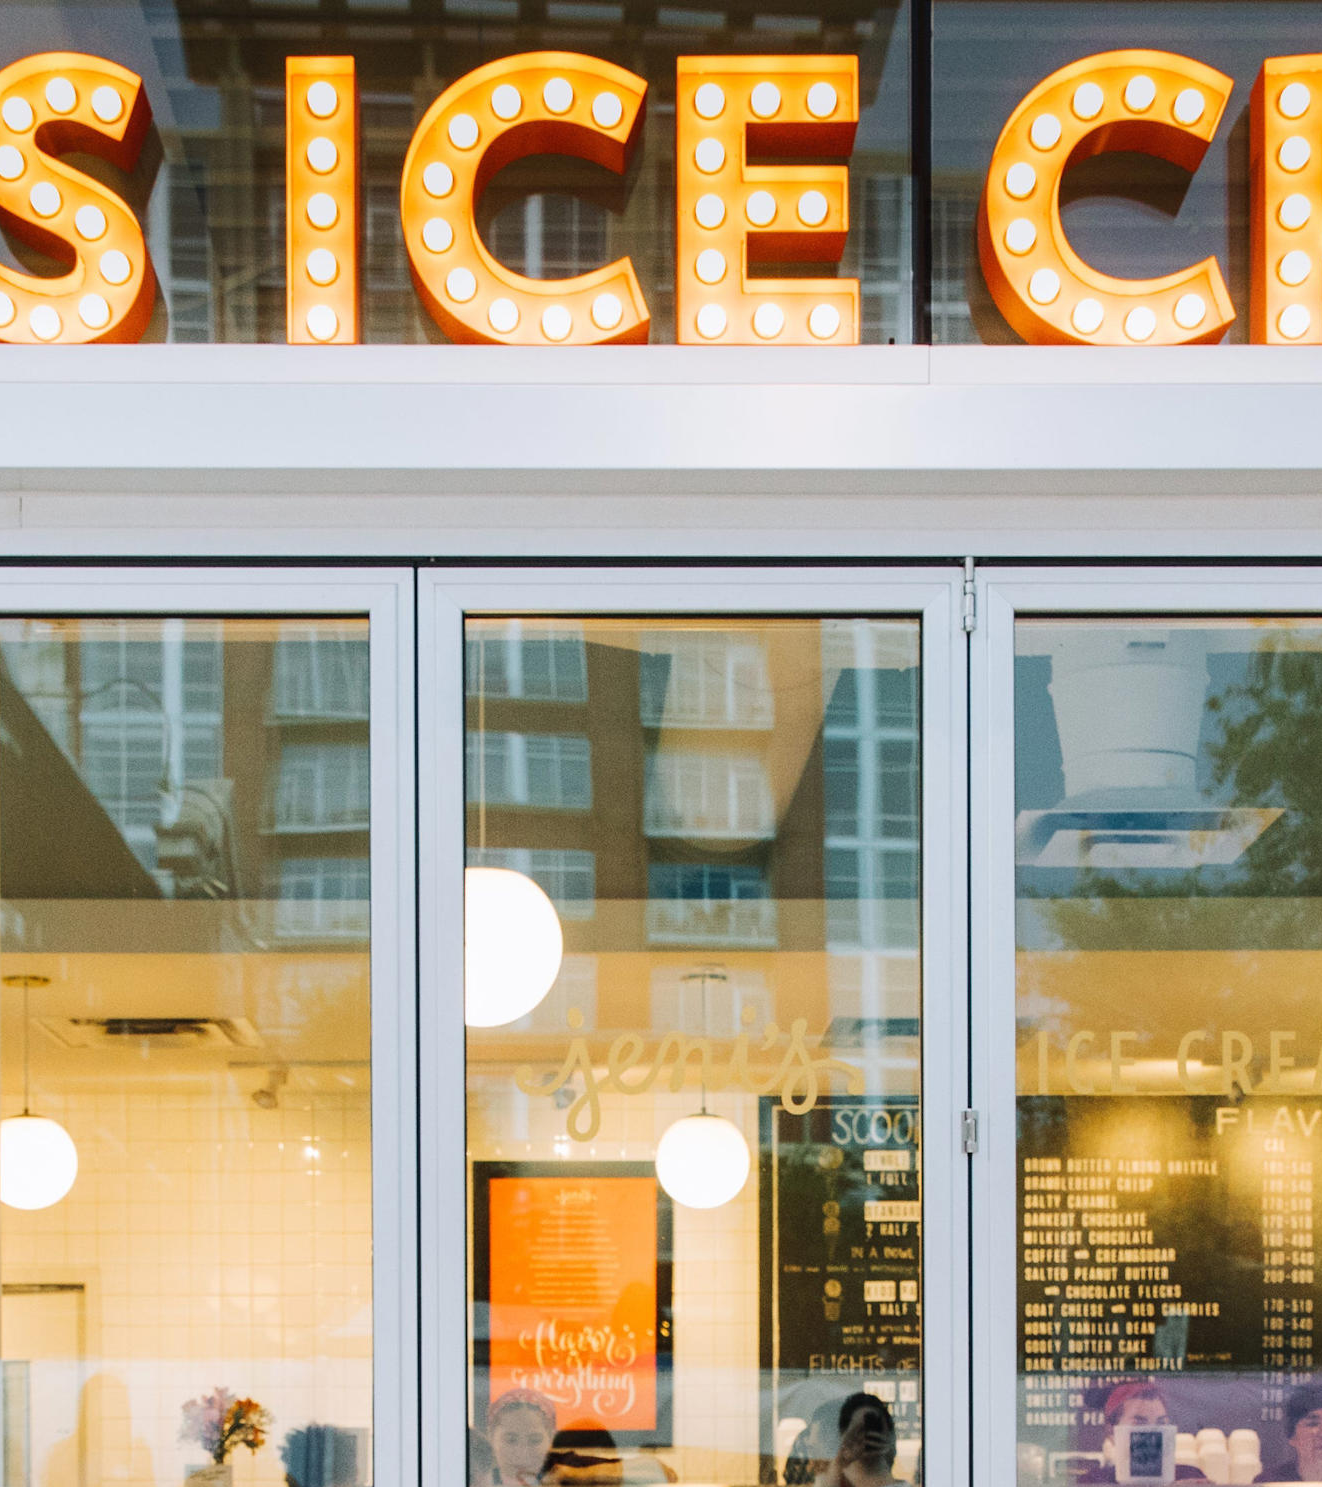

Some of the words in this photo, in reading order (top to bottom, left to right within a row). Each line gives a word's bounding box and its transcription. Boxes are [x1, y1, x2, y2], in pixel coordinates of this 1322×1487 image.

[284, 50, 860, 345] ICE
[514, 1006, 865, 1142] jeni's
[1038, 1031, 1137, 1095] ICE
[832, 1109, 919, 1145] SCOO
[1024, 1248, 1068, 1263] COFFEE
[1065, 1285, 1130, 1300] CHOCOLATE
[809, 1354, 886, 1376] FLIGHTS
[1083, 1411, 1106, 1425] PEA
